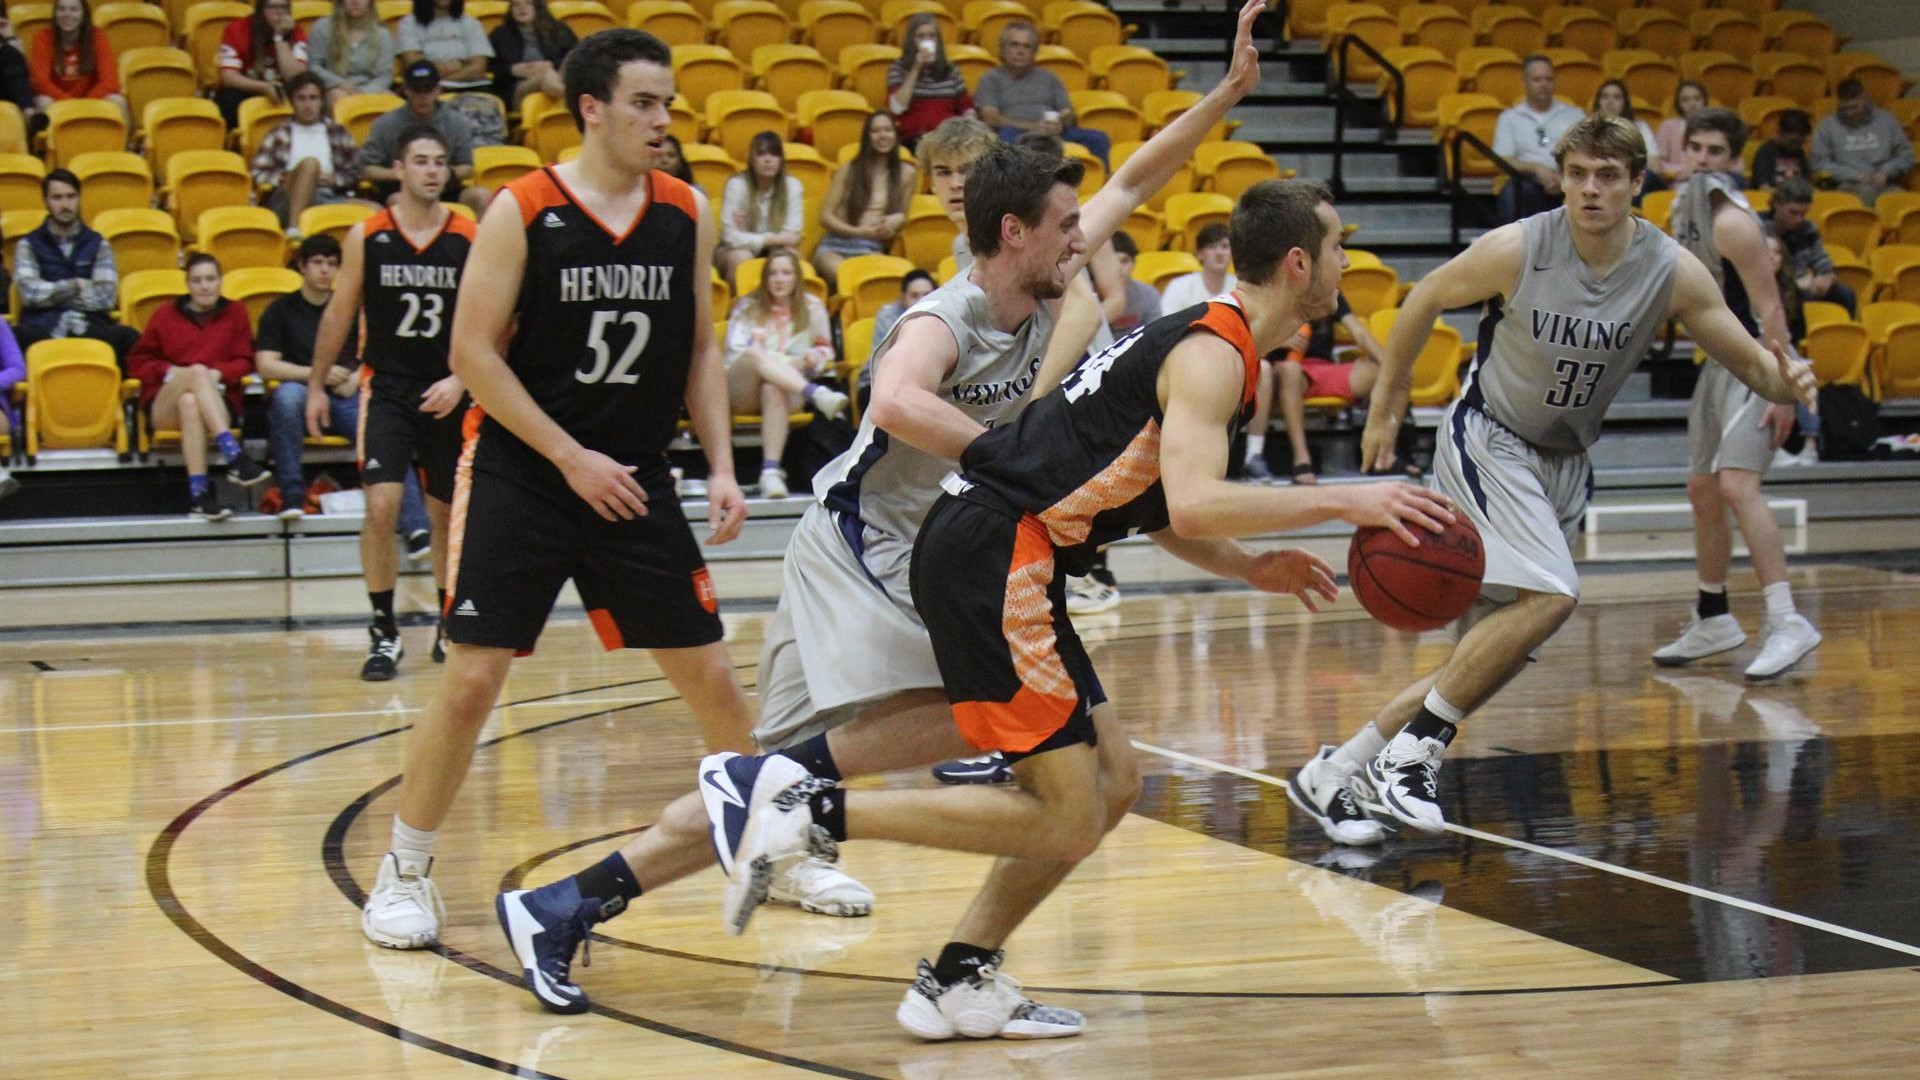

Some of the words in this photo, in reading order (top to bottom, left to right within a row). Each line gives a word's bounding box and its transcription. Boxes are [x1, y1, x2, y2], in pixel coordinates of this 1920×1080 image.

[380, 264, 457, 289] HENDRIX
[560, 264, 674, 302] HENDRIX
[395, 293, 444, 338] 23
[1531, 308, 1631, 350] VIKING
[574, 310, 651, 384] 52
[1546, 358, 1606, 409] 33
